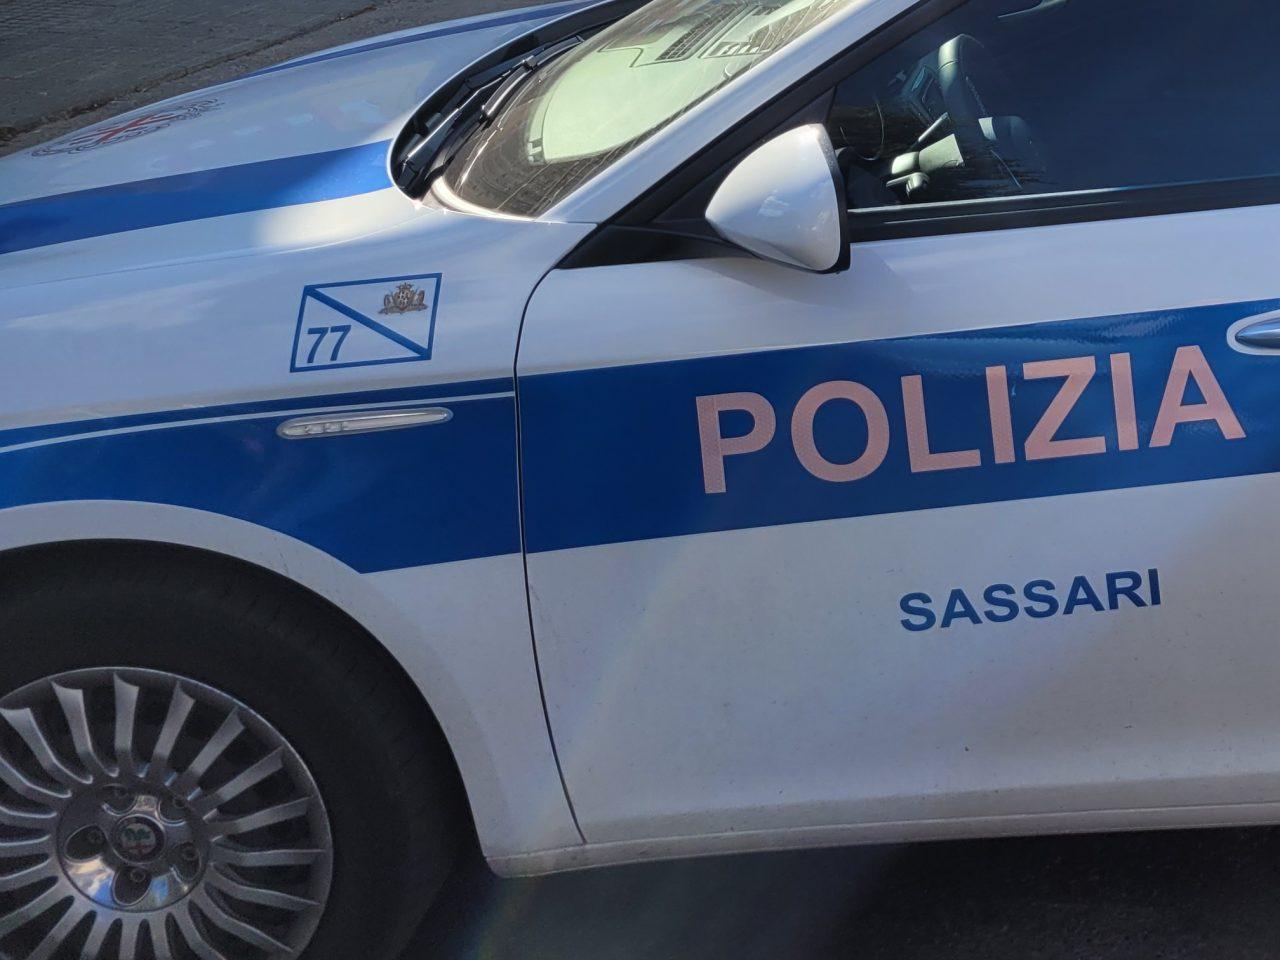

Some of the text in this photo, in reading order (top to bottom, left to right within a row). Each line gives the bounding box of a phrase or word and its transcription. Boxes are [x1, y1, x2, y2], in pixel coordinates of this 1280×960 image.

[306, 324, 352, 364] 77
[694, 344, 1247, 494] POLIZIA
[899, 567, 1162, 633] SASSARI
